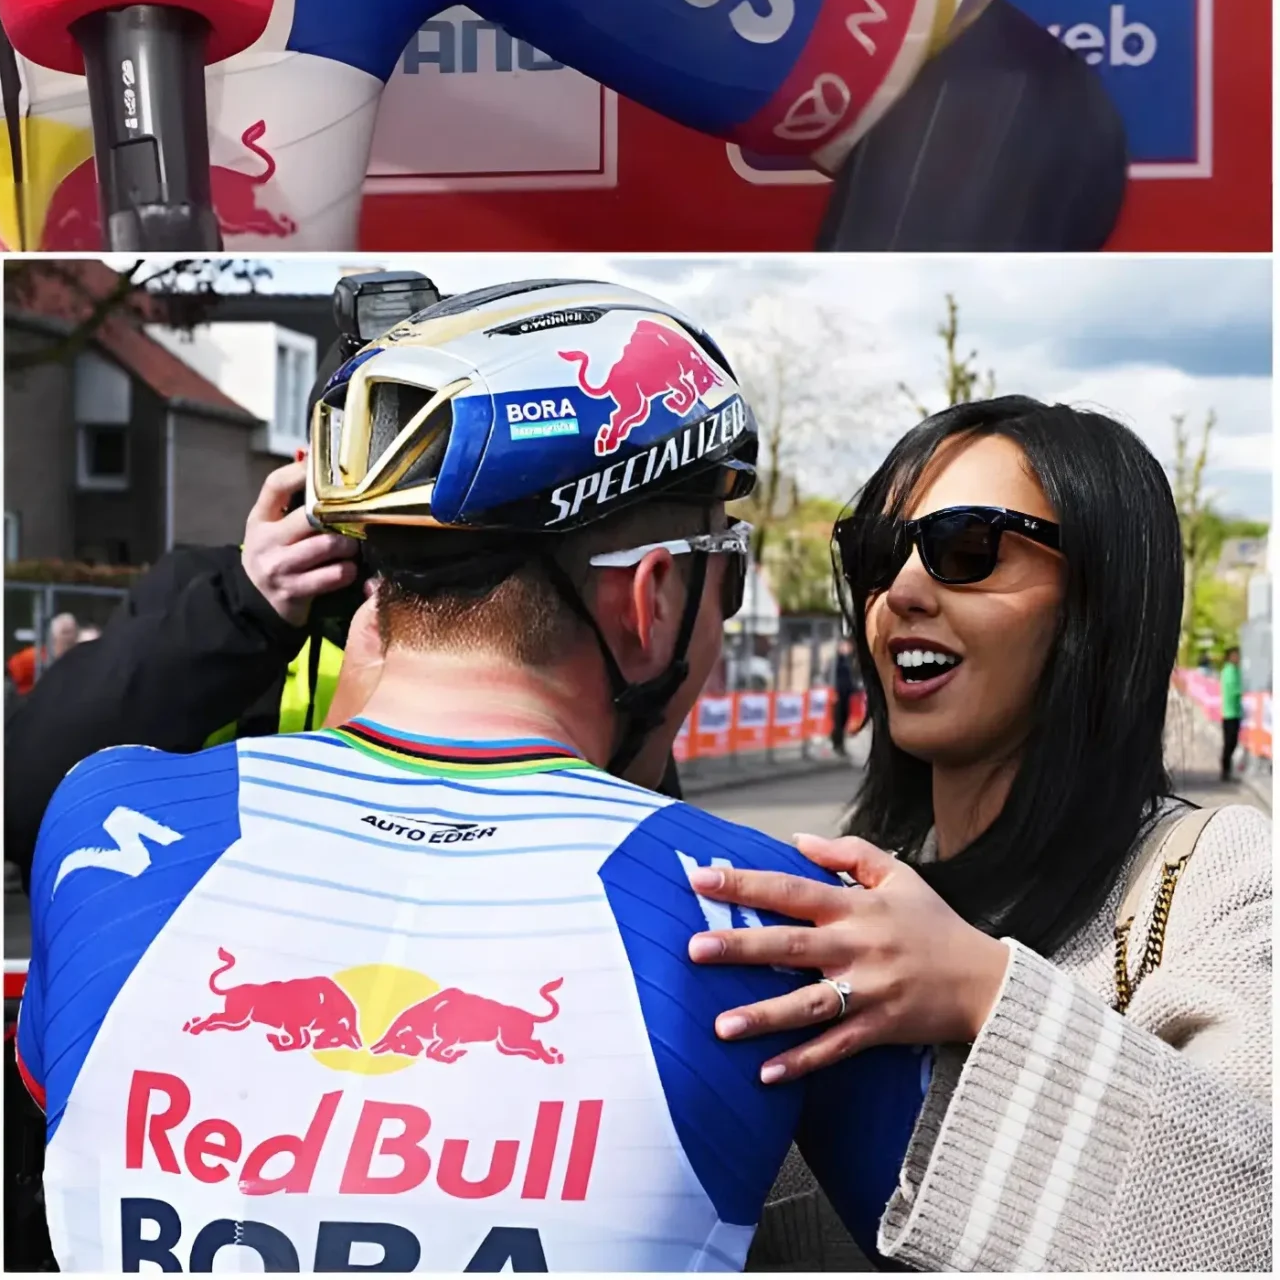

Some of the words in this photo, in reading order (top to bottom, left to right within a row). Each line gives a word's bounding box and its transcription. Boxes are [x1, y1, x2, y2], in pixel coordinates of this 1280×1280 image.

[1046, 4, 1158, 67] eb
[505, 397, 577, 424] BORA
[544, 397, 746, 527] SPECIALIZED
[360, 815, 426, 842] AUTO
[125, 1069, 345, 1196] Red
[338, 1098, 605, 1202] Bull
